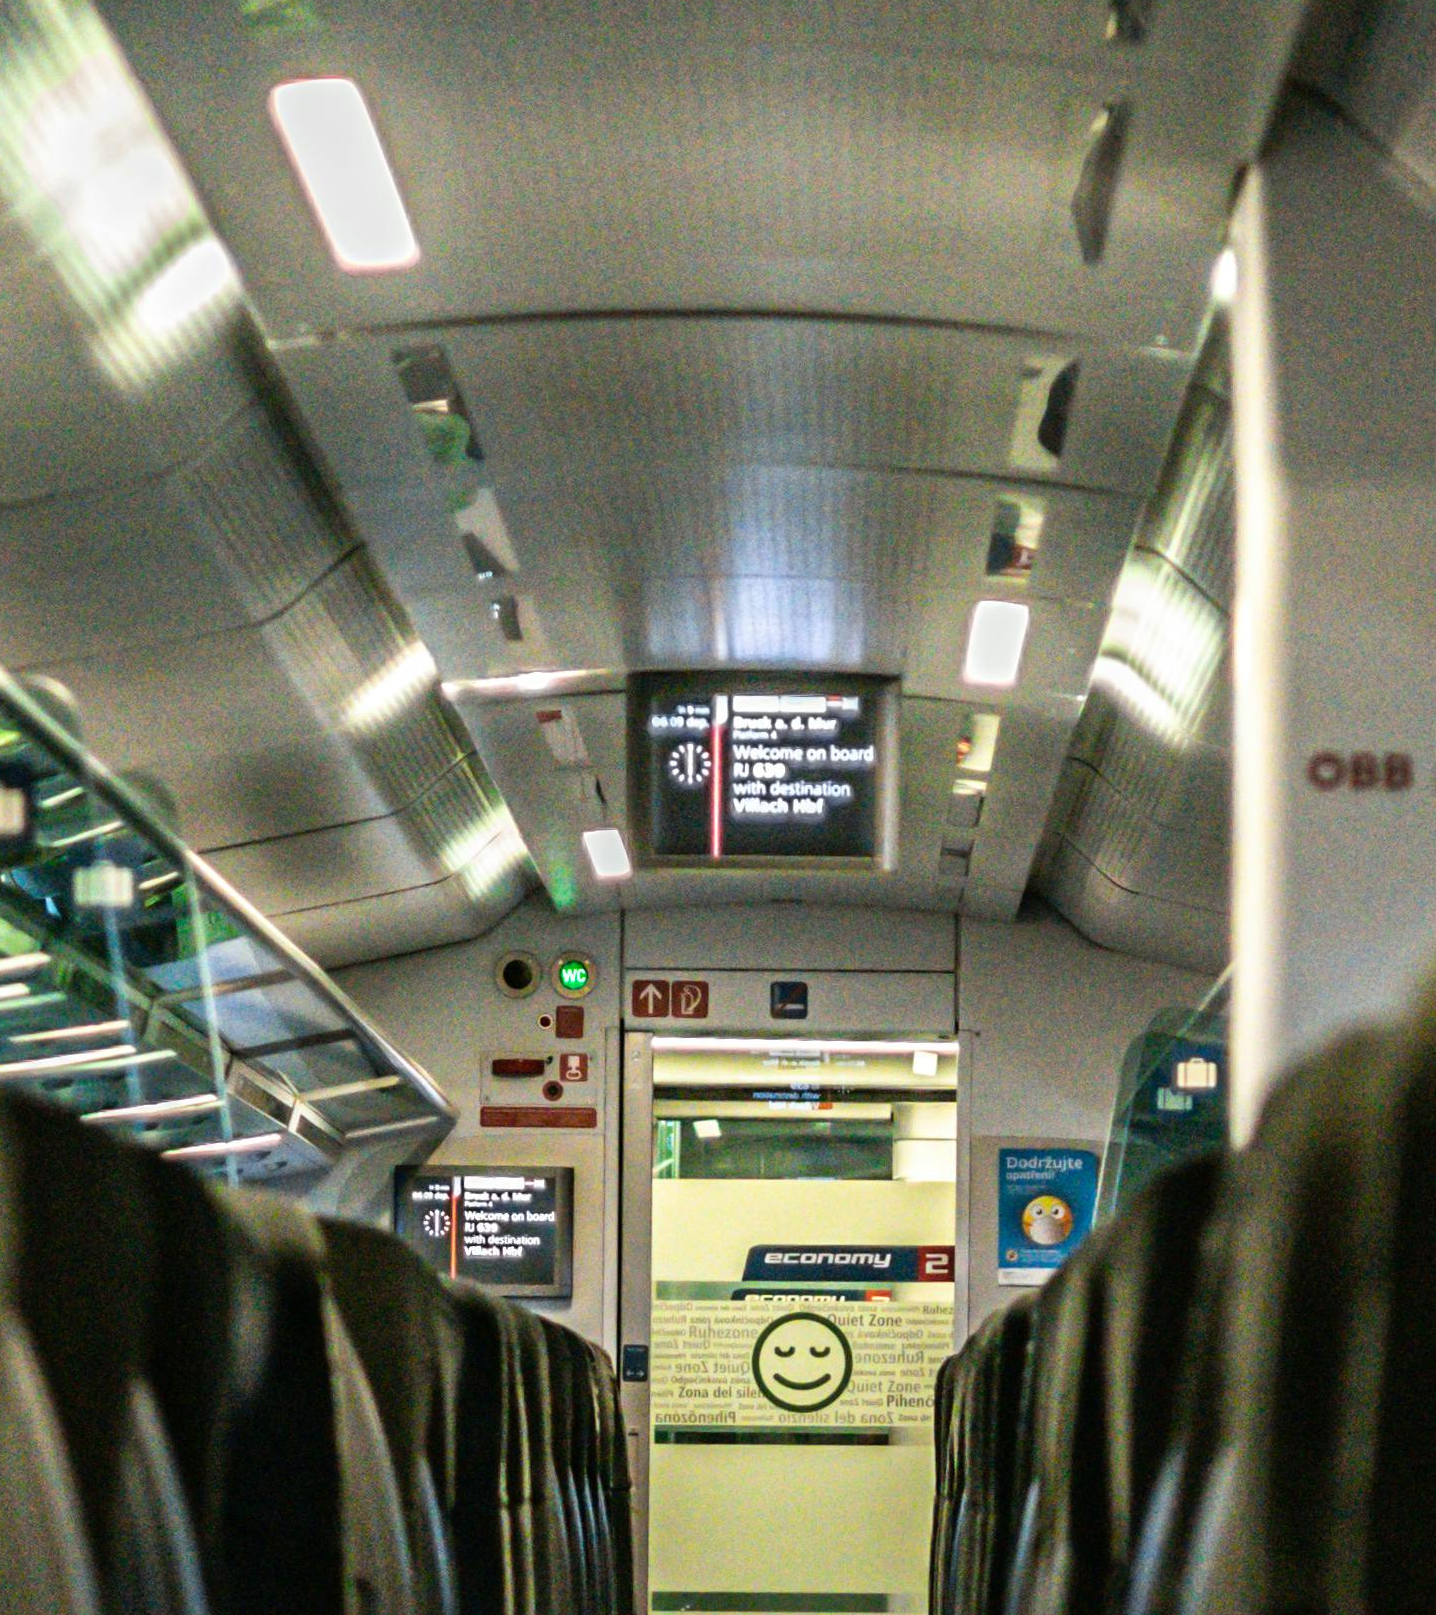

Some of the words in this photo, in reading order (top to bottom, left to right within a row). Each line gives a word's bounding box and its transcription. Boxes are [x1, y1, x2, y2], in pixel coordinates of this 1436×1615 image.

[733, 745, 804, 761] Welcome
[806, 748, 827, 761] on
[830, 745, 874, 762] board
[733, 782, 766, 796] with
[770, 781, 851, 797] destination
[733, 798, 789, 814] Villach
[562, 967, 589, 983] WC
[1006, 1156, 1083, 1172] Dodržujte
[464, 1211, 510, 1221] Welcome
[511, 1213, 524, 1221] on
[526, 1210, 555, 1221] board
[476, 1223, 498, 1232] 639
[464, 1235, 485, 1245] with
[488, 1235, 540, 1245] destination
[764, 1252, 892, 1268] economy
[925, 1253, 949, 1274] 2
[827, 1313, 864, 1327] Quiet
[868, 1313, 902, 1327] Zone
[688, 1325, 759, 1339] Ruhezone
[677, 1386, 709, 1399] Zona
[712, 1386, 733, 1399] del
[886, 1380, 921, 1393] Zone
